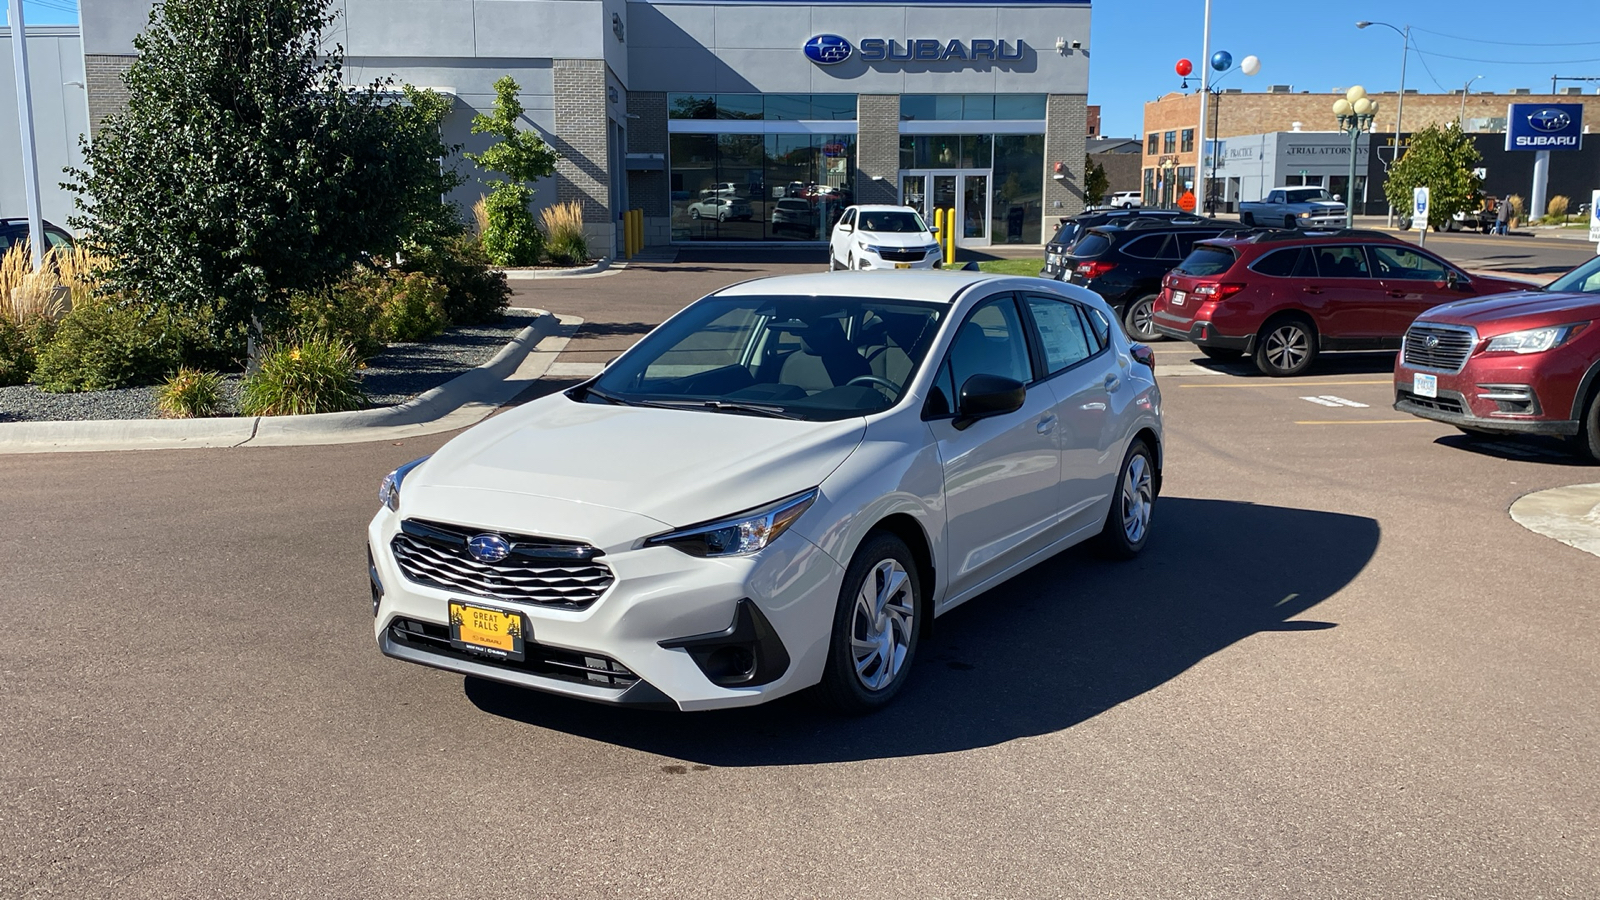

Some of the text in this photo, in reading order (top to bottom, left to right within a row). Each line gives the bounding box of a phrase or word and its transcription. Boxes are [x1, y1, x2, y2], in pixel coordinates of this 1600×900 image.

[860, 38, 1024, 61] SUBARU
[1516, 136, 1577, 146] SUBARU
[1230, 147, 1253, 158] PRACTICE
[1290, 147, 1369, 155] TRIAL ATTORNYS
[473, 611, 498, 623] GREAT
[474, 620, 499, 632] FALLS
[480, 637, 502, 645] SUBARU
